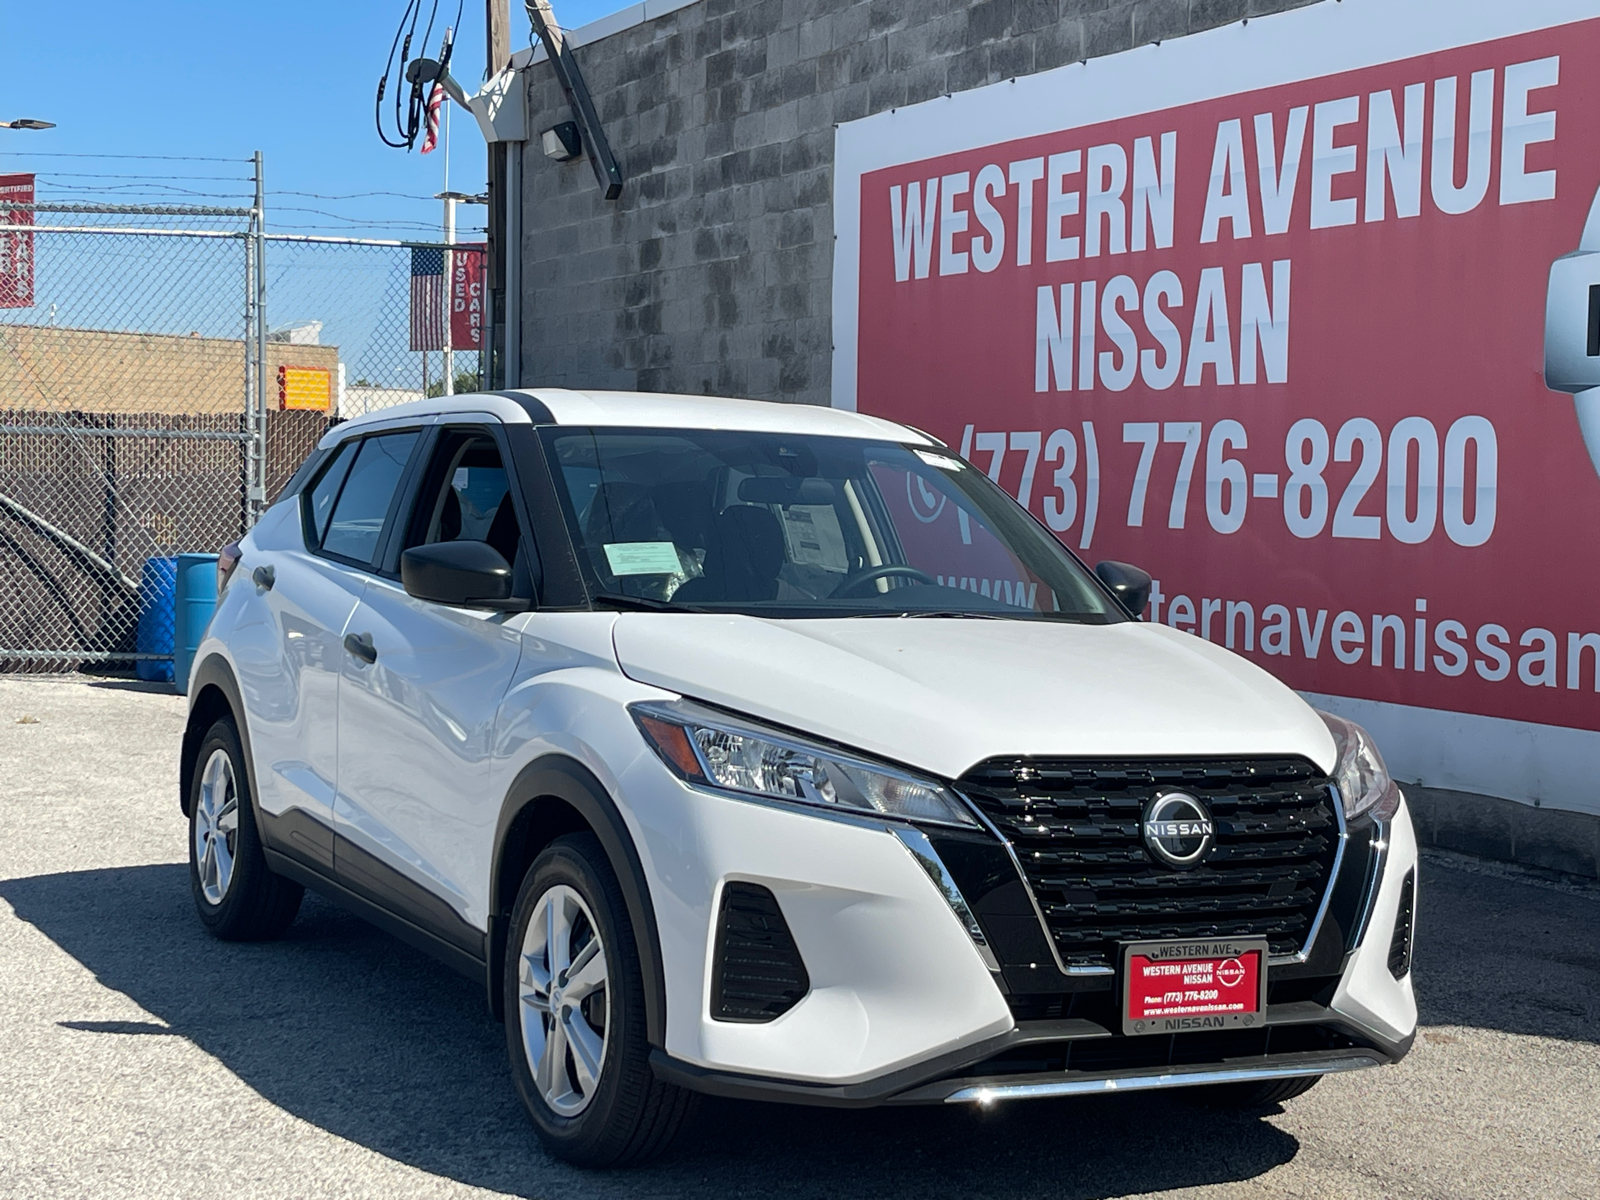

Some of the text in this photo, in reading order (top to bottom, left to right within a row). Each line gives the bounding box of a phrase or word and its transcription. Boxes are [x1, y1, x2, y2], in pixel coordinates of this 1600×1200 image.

[889, 55, 1560, 283] WESTERN AVENUE
[454, 252, 468, 312] USED
[469, 282, 481, 343] CARS
[1034, 259, 1291, 393] NISSAN
[957, 421, 1100, 550] (773)
[1123, 415, 1498, 547] 776-8200
[1146, 823, 1212, 835] NISSAN
[1159, 945, 1209, 957] WESTERN
[1143, 963, 1213, 976] WESTERN AVENUE
[1184, 974, 1213, 984] NISSAN
[1163, 992, 1183, 1004] (773)
[1184, 990, 1218, 1001] 776-8200
[1143, 1003, 1244, 1016] www.westernavenissan.com
[1165, 1016, 1224, 1030] NISSAN
